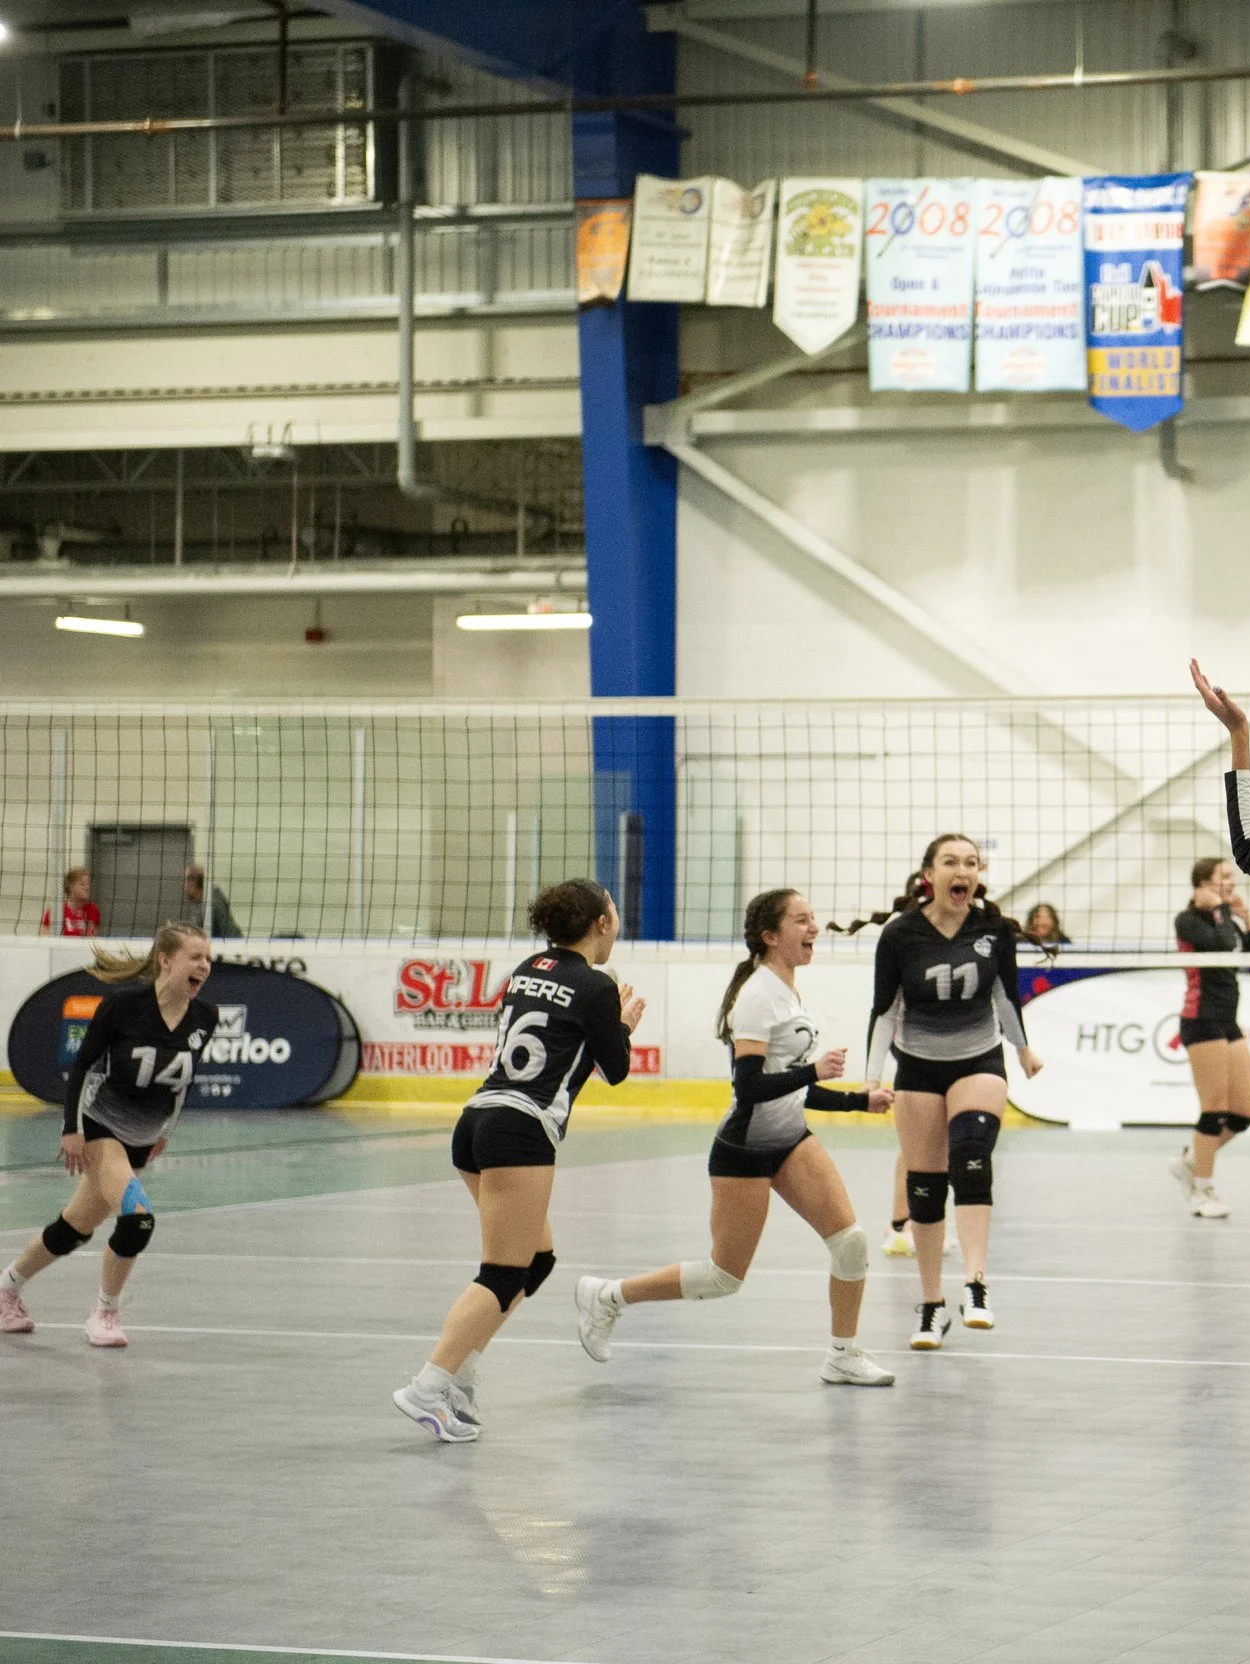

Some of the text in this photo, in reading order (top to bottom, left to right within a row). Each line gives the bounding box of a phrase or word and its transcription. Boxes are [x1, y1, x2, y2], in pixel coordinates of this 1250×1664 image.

[867, 201, 971, 238] 2008
[978, 200, 1079, 238] 2008
[1107, 352, 1176, 370] WORLD
[925, 962, 979, 1000] 11
[200, 1032, 291, 1064] erloo
[491, 1005, 549, 1081] 16
[1076, 1022, 1146, 1053] HTG
[131, 1047, 193, 1094] 14
